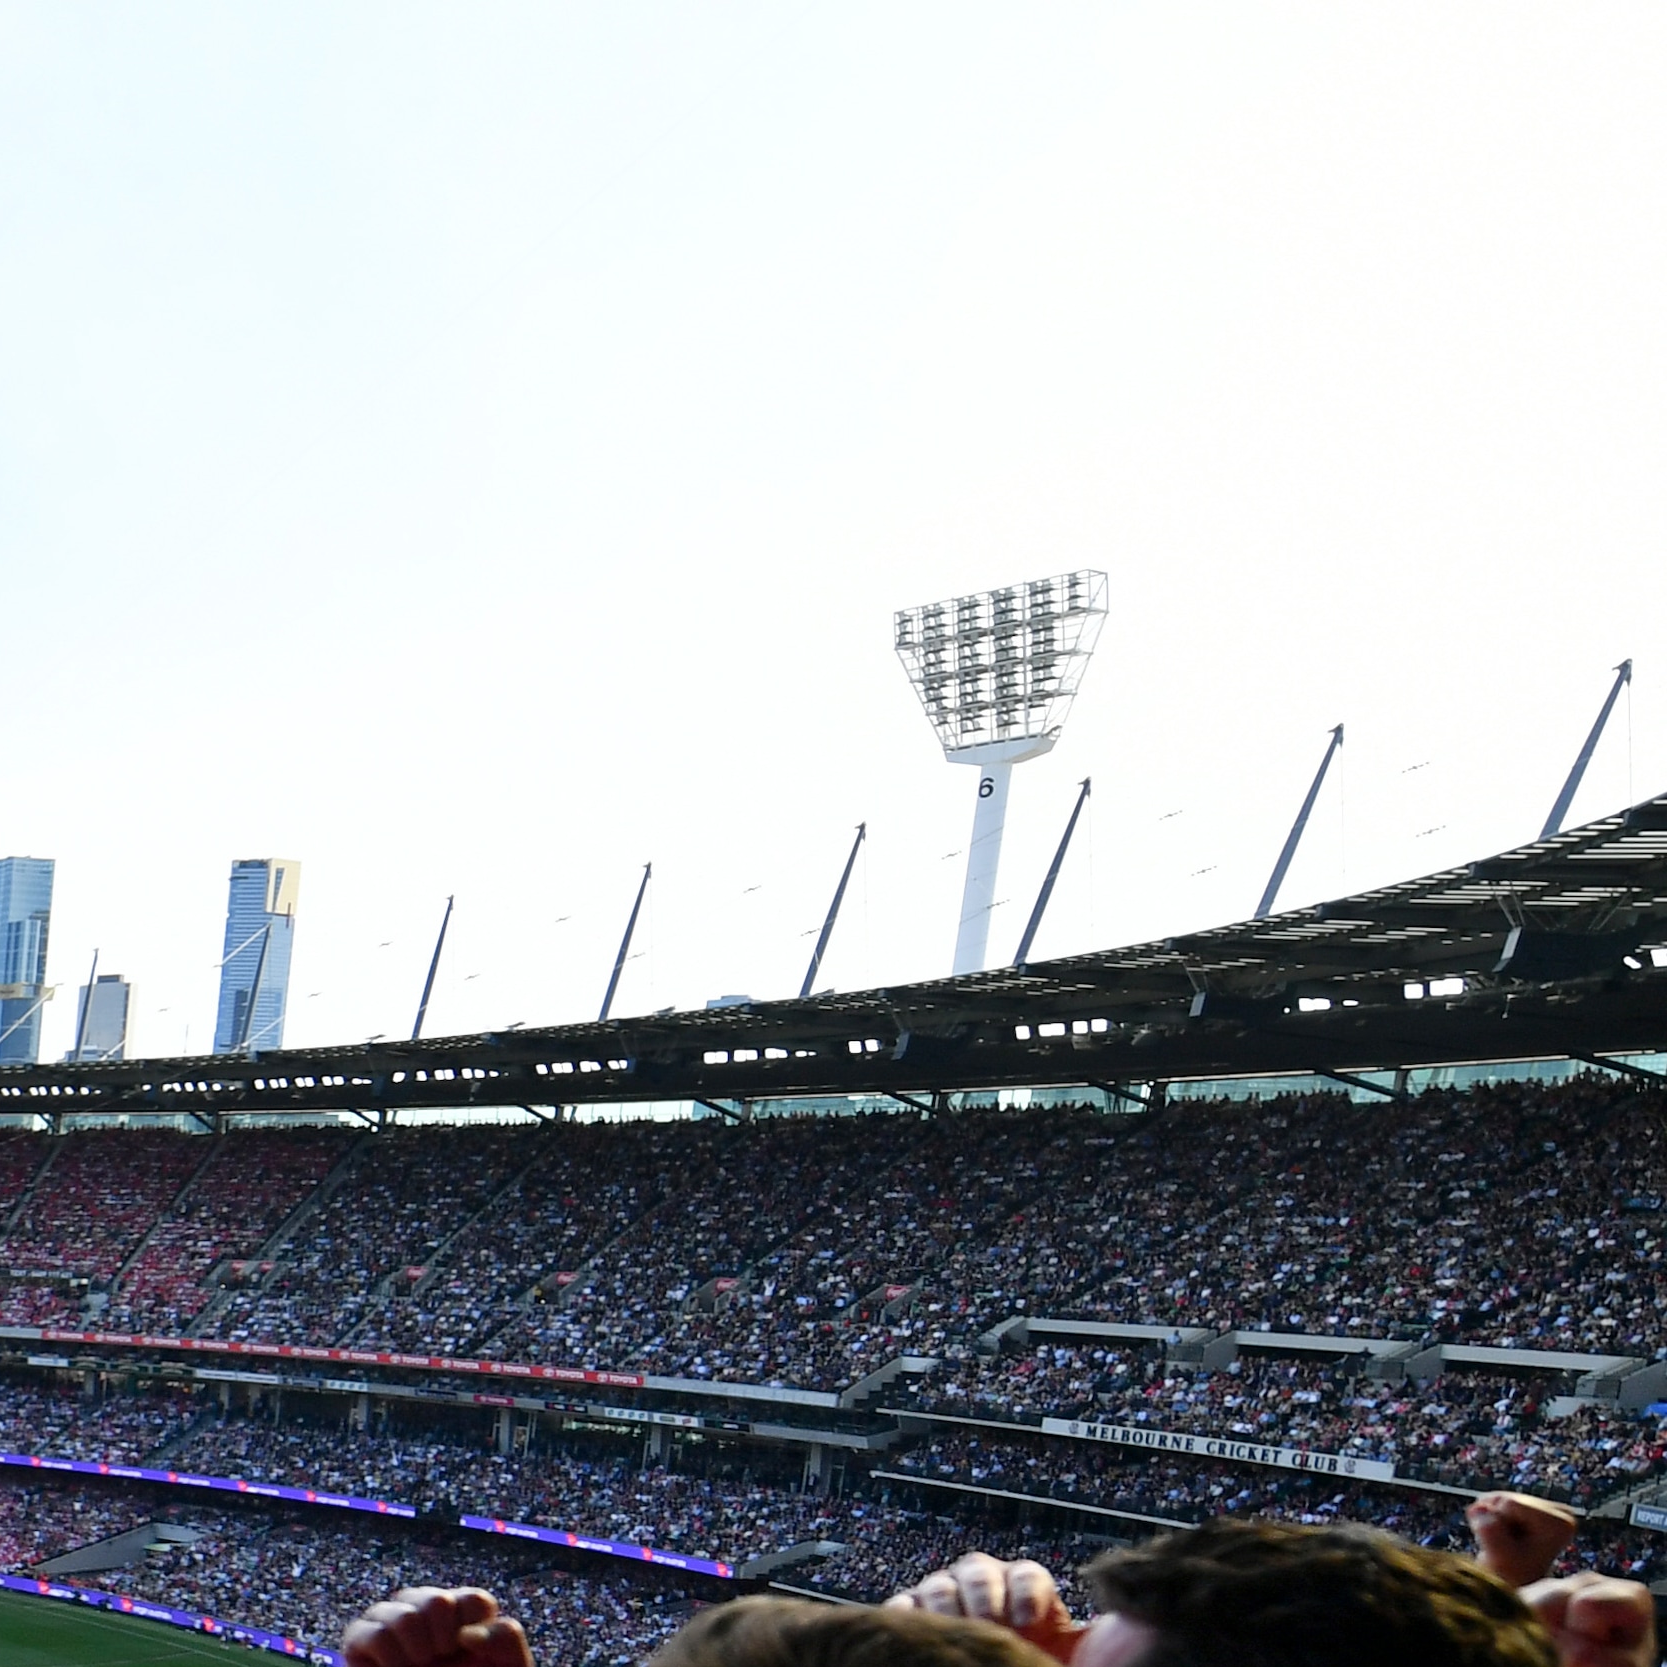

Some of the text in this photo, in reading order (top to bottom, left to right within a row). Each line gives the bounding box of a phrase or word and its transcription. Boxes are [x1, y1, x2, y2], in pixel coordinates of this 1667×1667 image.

[979, 776, 995, 799] 6
[203, 1341, 229, 1349] TOYOTA
[252, 1345, 279, 1353] TOYOTA
[303, 1349, 329, 1357] TOYOTA
[351, 1353, 378, 1361] TOYOTA
[402, 1356, 429, 1365] TOYOTA
[453, 1361, 479, 1370] TOYOTA
[503, 1365, 531, 1375] TOYOTA
[556, 1370, 584, 1379] TOYOTA
[610, 1374, 638, 1384] TOYOTA
[1086, 1425, 1338, 1472] MELBOURNE CRICKET CLUB
